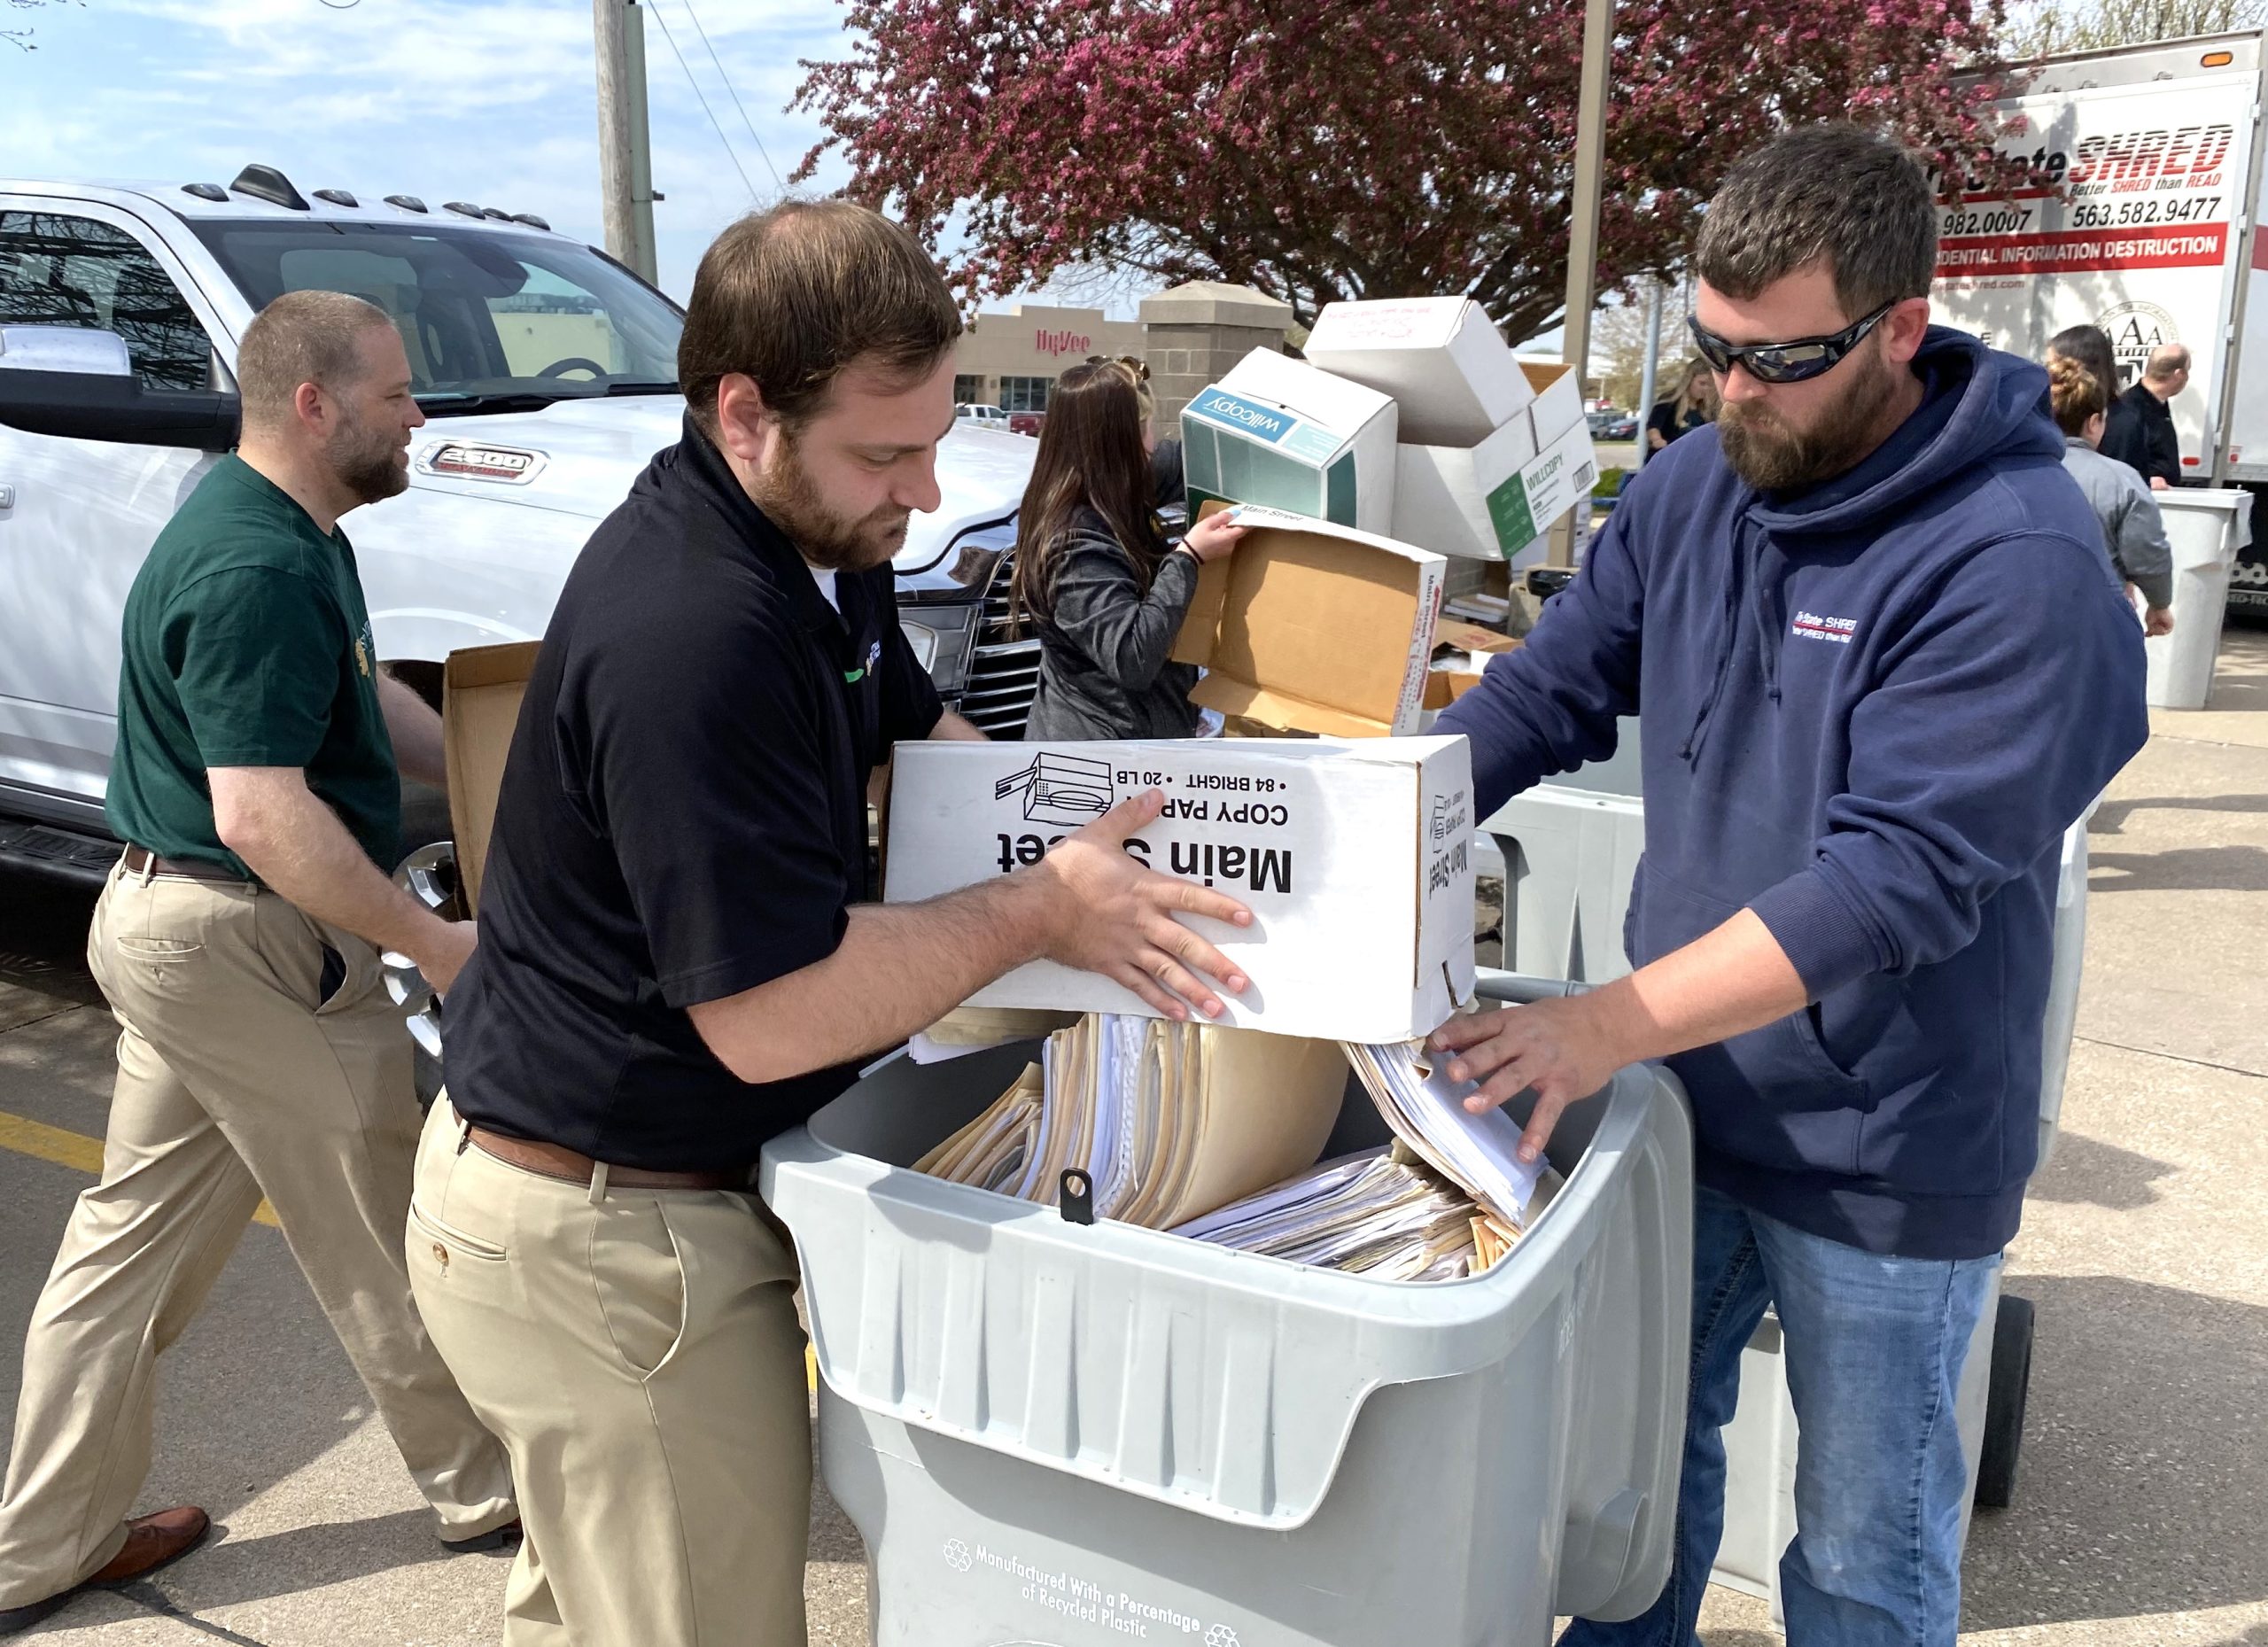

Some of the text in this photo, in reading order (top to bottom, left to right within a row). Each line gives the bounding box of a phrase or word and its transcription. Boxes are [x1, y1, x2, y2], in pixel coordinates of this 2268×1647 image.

[2069, 124, 2233, 183] SHRED
[2070, 173, 2222, 198] Better SHRED than READ
[1943, 197, 2222, 236] 982.0007 563.582.9477
[2001, 241, 2101, 262] INFORMATION
[2104, 236, 2218, 259] DESTRUCTION
[1204, 396, 1279, 432] willcopy
[438, 447, 527, 470] 2500
[1526, 452, 1564, 491] WILLCOPY
[1241, 505, 1304, 522] Main Street
[1420, 574, 1435, 639] Main Street
[1825, 617, 1858, 631] SHRED
[1116, 770, 1276, 793] 84 BRIGHT 20 LB
[1216, 801, 1289, 827] COPY
[998, 833, 1292, 894] Main Set
[1429, 838, 1467, 901] Main Street
[975, 1544, 1200, 1633] Manufactured With a Percentage
[1021, 1584, 1147, 1639] of Recycled Plastic
